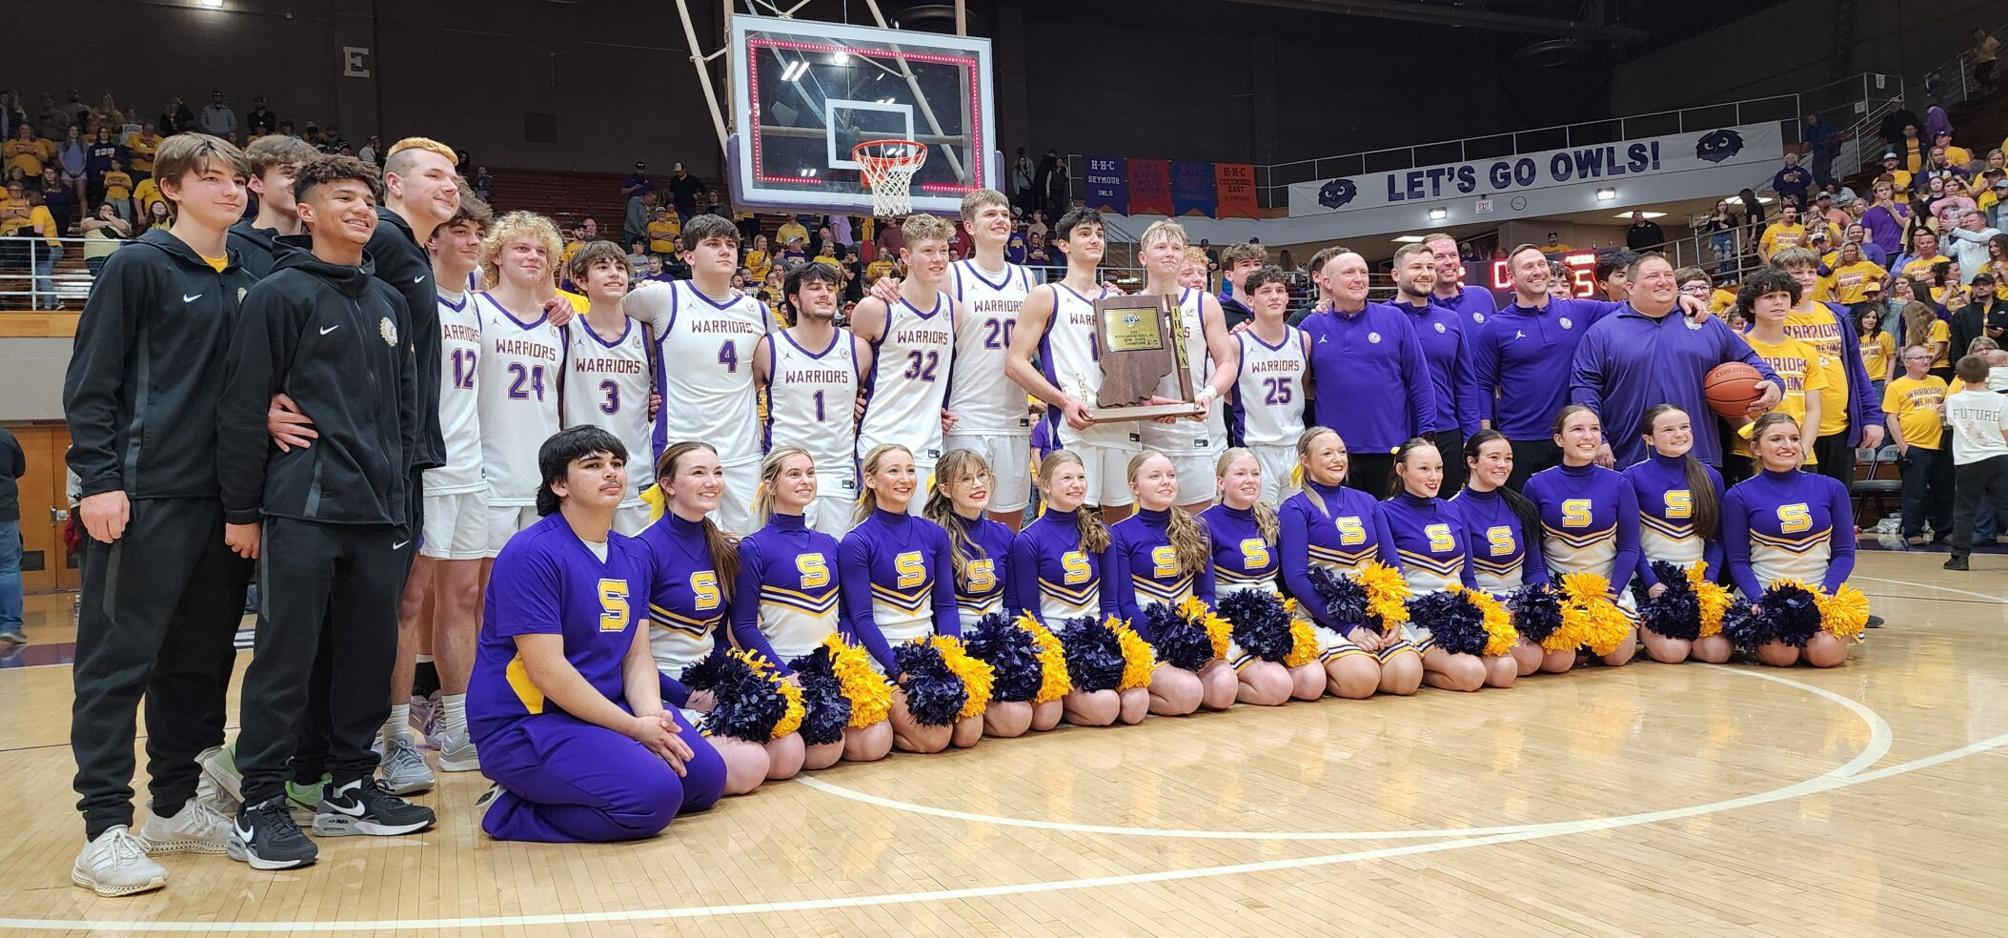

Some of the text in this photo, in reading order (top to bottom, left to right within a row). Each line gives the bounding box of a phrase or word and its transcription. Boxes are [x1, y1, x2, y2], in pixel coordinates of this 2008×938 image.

[343, 46, 370, 78] E
[1088, 175, 1120, 184] SEYMOUR
[1387, 141, 1661, 202] LET'S GO OWLS!
[1478, 202, 1490, 210] EXIT
[1575, 270, 1594, 297] 5
[444, 324, 480, 344] ARRIORS
[691, 319, 754, 334] WARRIORS
[897, 330, 949, 345] WARRIORS
[1172, 307, 1189, 366] IHSAA
[496, 338, 556, 361] WARRIORS
[717, 338, 739, 374] 4
[451, 347, 477, 390] 12
[507, 361, 545, 402] 24
[576, 358, 641, 375] WARRIORS
[786, 370, 848, 384] WARRIORS
[904, 350, 940, 382] 32
[1251, 360, 1300, 374] WARRIORS
[600, 379, 621, 415] 3
[812, 389, 826, 423] 1
[1262, 377, 1293, 406] 25
[1953, 409, 2000, 421] FUTURE
[1562, 499, 1592, 527] S
[1664, 489, 1694, 519] S
[1777, 503, 1812, 534] S
[1335, 516, 1367, 545] S
[1425, 524, 1455, 552] S
[1487, 526, 1516, 556] S
[1062, 551, 1092, 585] S
[1151, 545, 1180, 578] S
[1240, 538, 1270, 569] S
[796, 553, 830, 589] S
[895, 550, 927, 589] S
[967, 559, 996, 593] S
[598, 578, 630, 632] S
[690, 570, 721, 611] S
